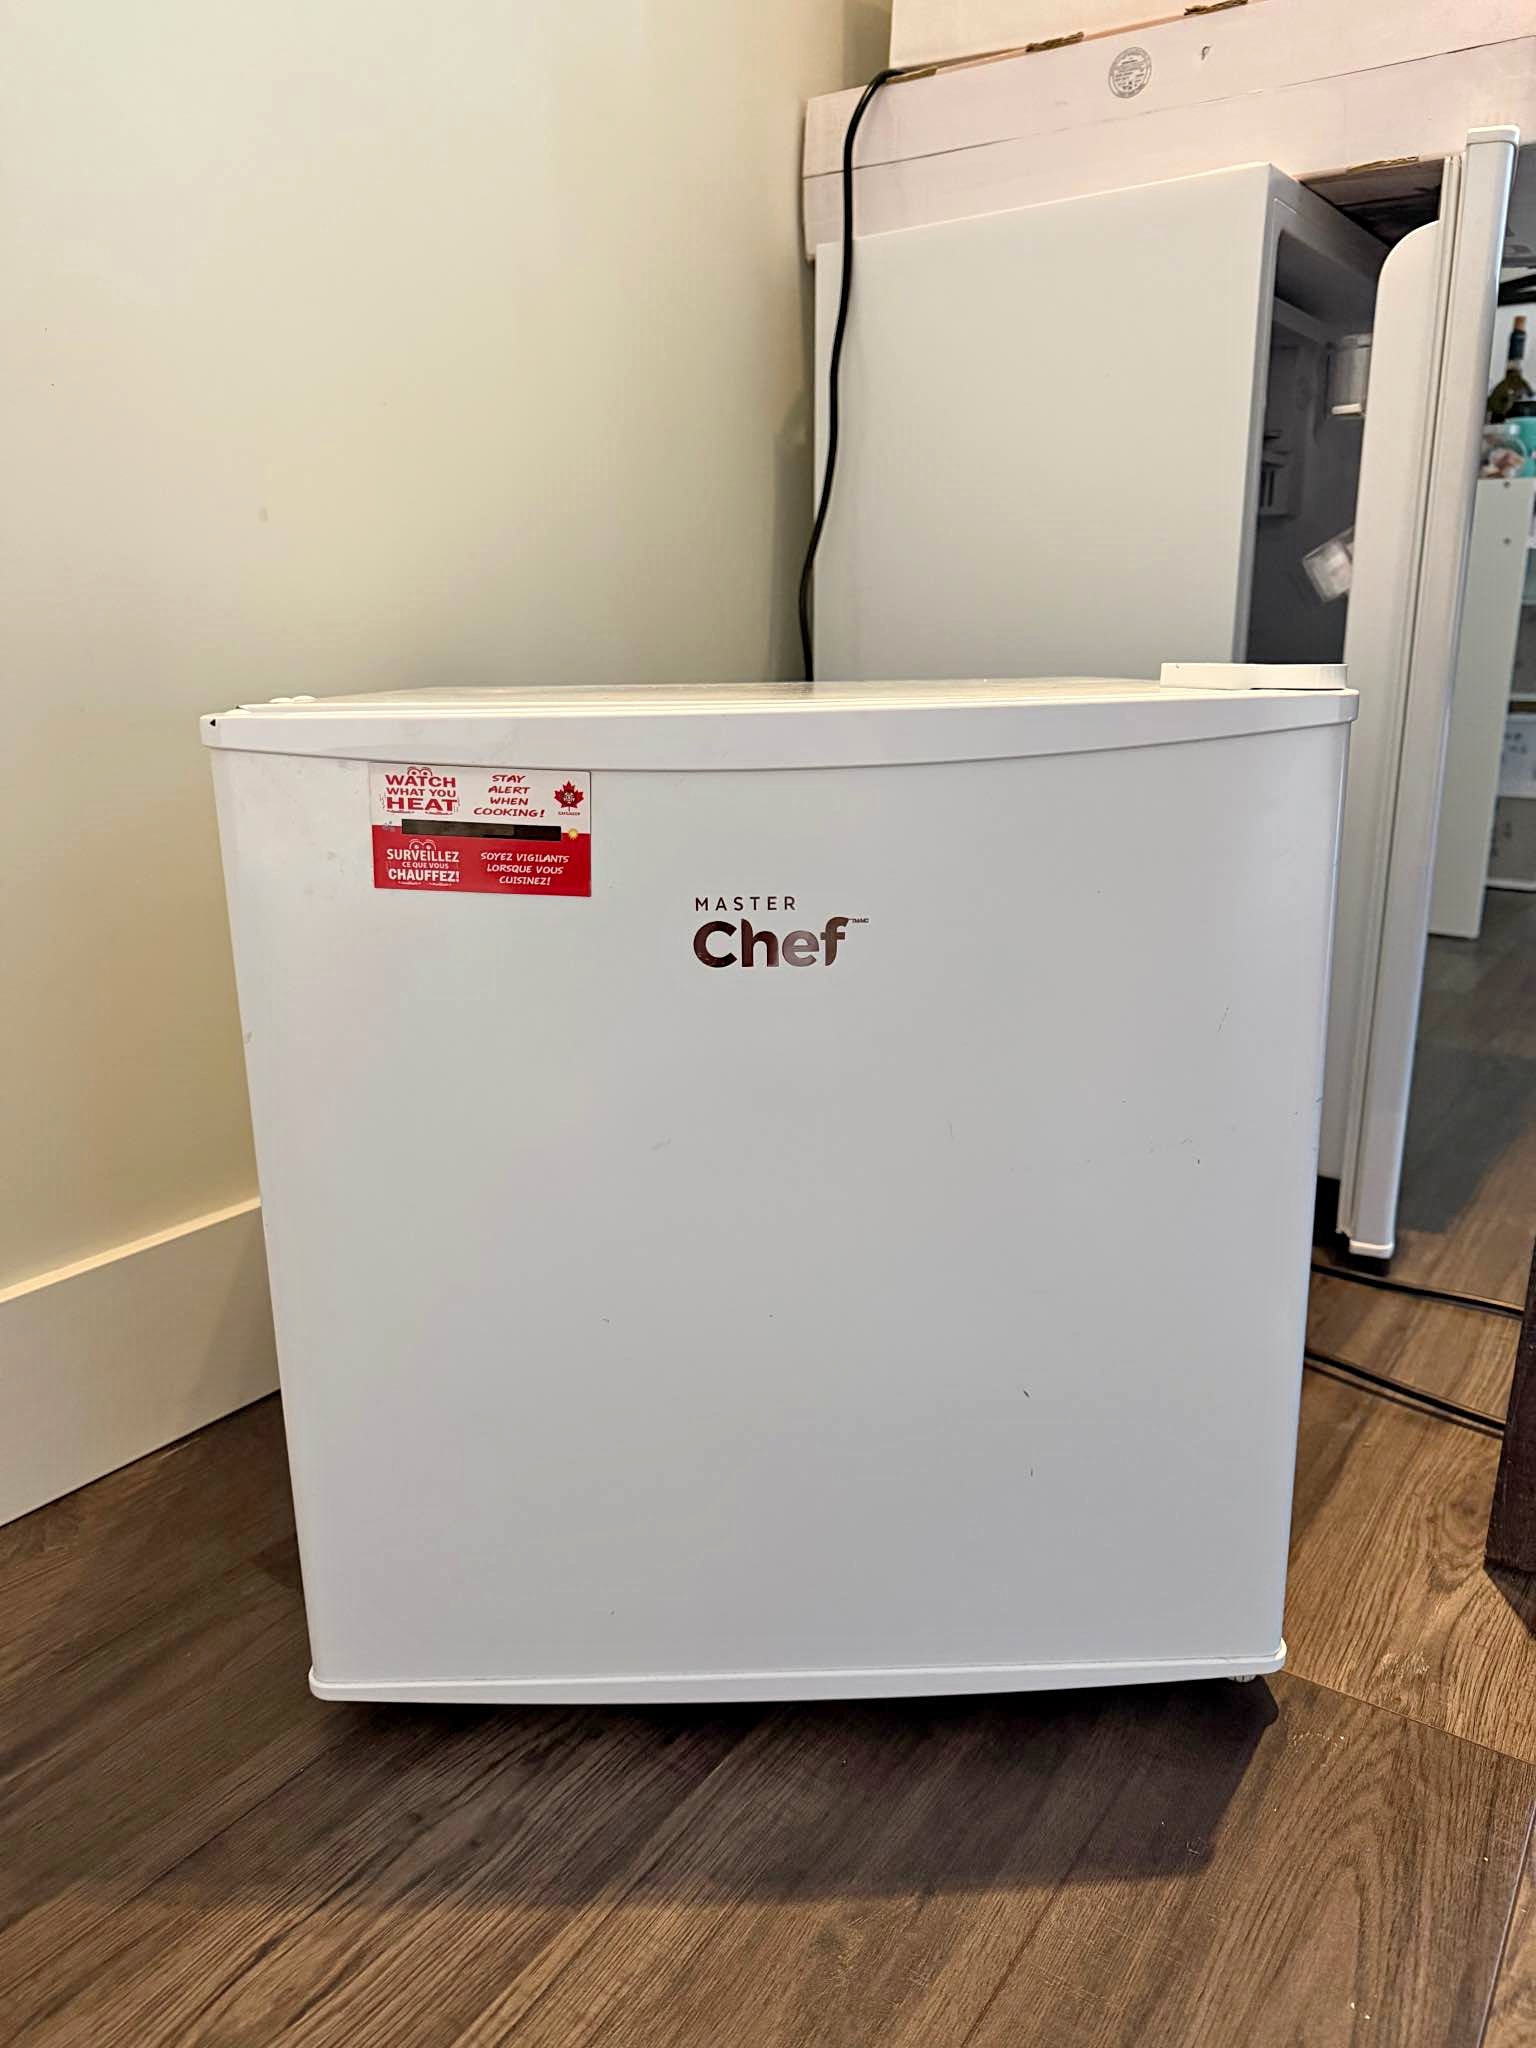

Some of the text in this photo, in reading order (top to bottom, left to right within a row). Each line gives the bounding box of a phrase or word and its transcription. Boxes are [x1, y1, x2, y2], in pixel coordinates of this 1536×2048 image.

[385, 774, 456, 787] WATCH
[492, 774, 526, 783] STAY
[386, 788, 456, 798] WHAT YOU
[487, 786, 530, 794] ALERT
[386, 797, 457, 812] HEAT
[489, 797, 529, 806] WHEN
[473, 807, 545, 818] COOKING!
[386, 848, 460, 863] SURVEILLEZ
[480, 852, 569, 863] SOYEZ VIGILANTS
[487, 864, 564, 875] LORSQUE VOUS
[388, 869, 460, 883] CHAUFFEZ!
[499, 876, 551, 886] CUISINEZ!
[695, 896, 796, 911] MASTER
[693, 916, 849, 968] Chef
